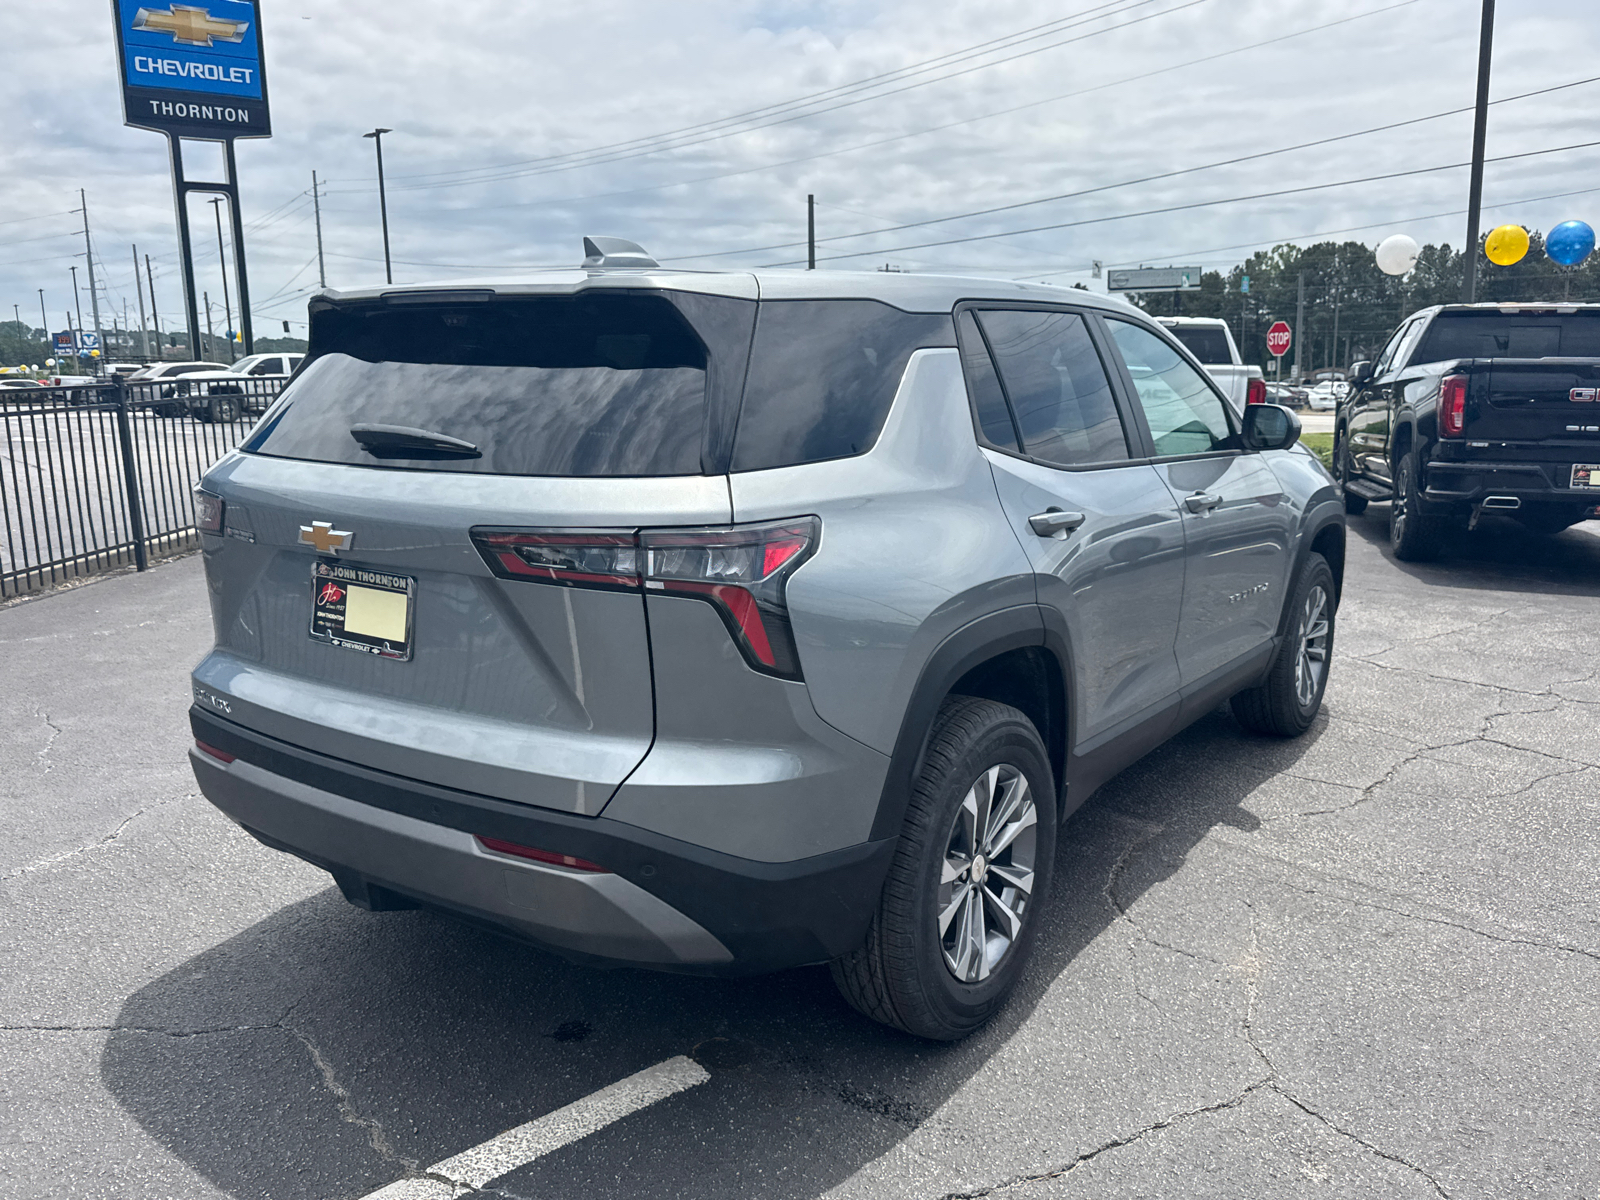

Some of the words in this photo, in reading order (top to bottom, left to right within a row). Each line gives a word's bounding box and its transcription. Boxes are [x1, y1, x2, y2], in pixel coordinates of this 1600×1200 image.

[134, 56, 253, 84] CHEVROLET
[149, 100, 249, 123] THORNTON
[1269, 332, 1289, 345] STOP
[334, 566, 356, 580] JOHN
[357, 571, 406, 589] THORNTON
[341, 641, 371, 653] CHEVROLET
